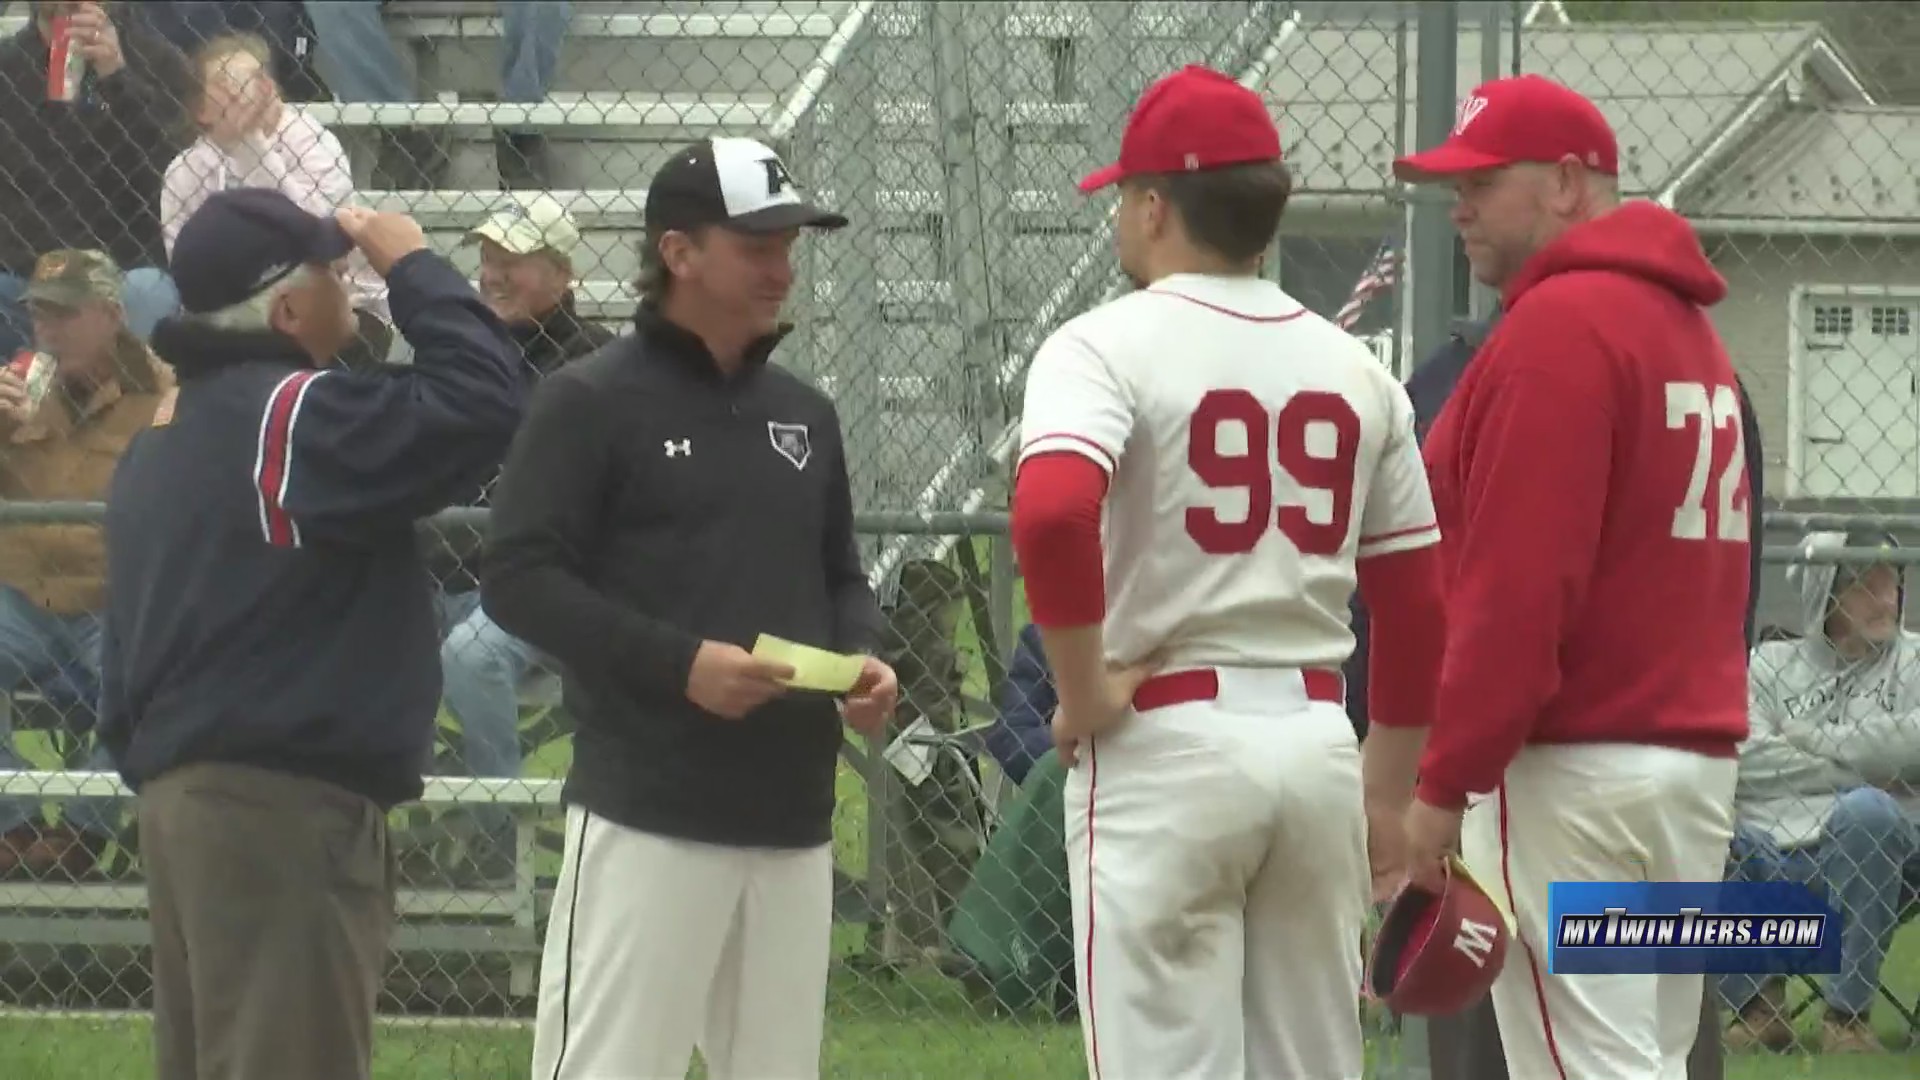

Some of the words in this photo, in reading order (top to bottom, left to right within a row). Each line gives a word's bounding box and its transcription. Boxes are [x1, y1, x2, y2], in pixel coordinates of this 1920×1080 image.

[1184, 388, 1361, 556] 99
[1665, 382, 1749, 542] 72
[1453, 917, 1498, 969] W
